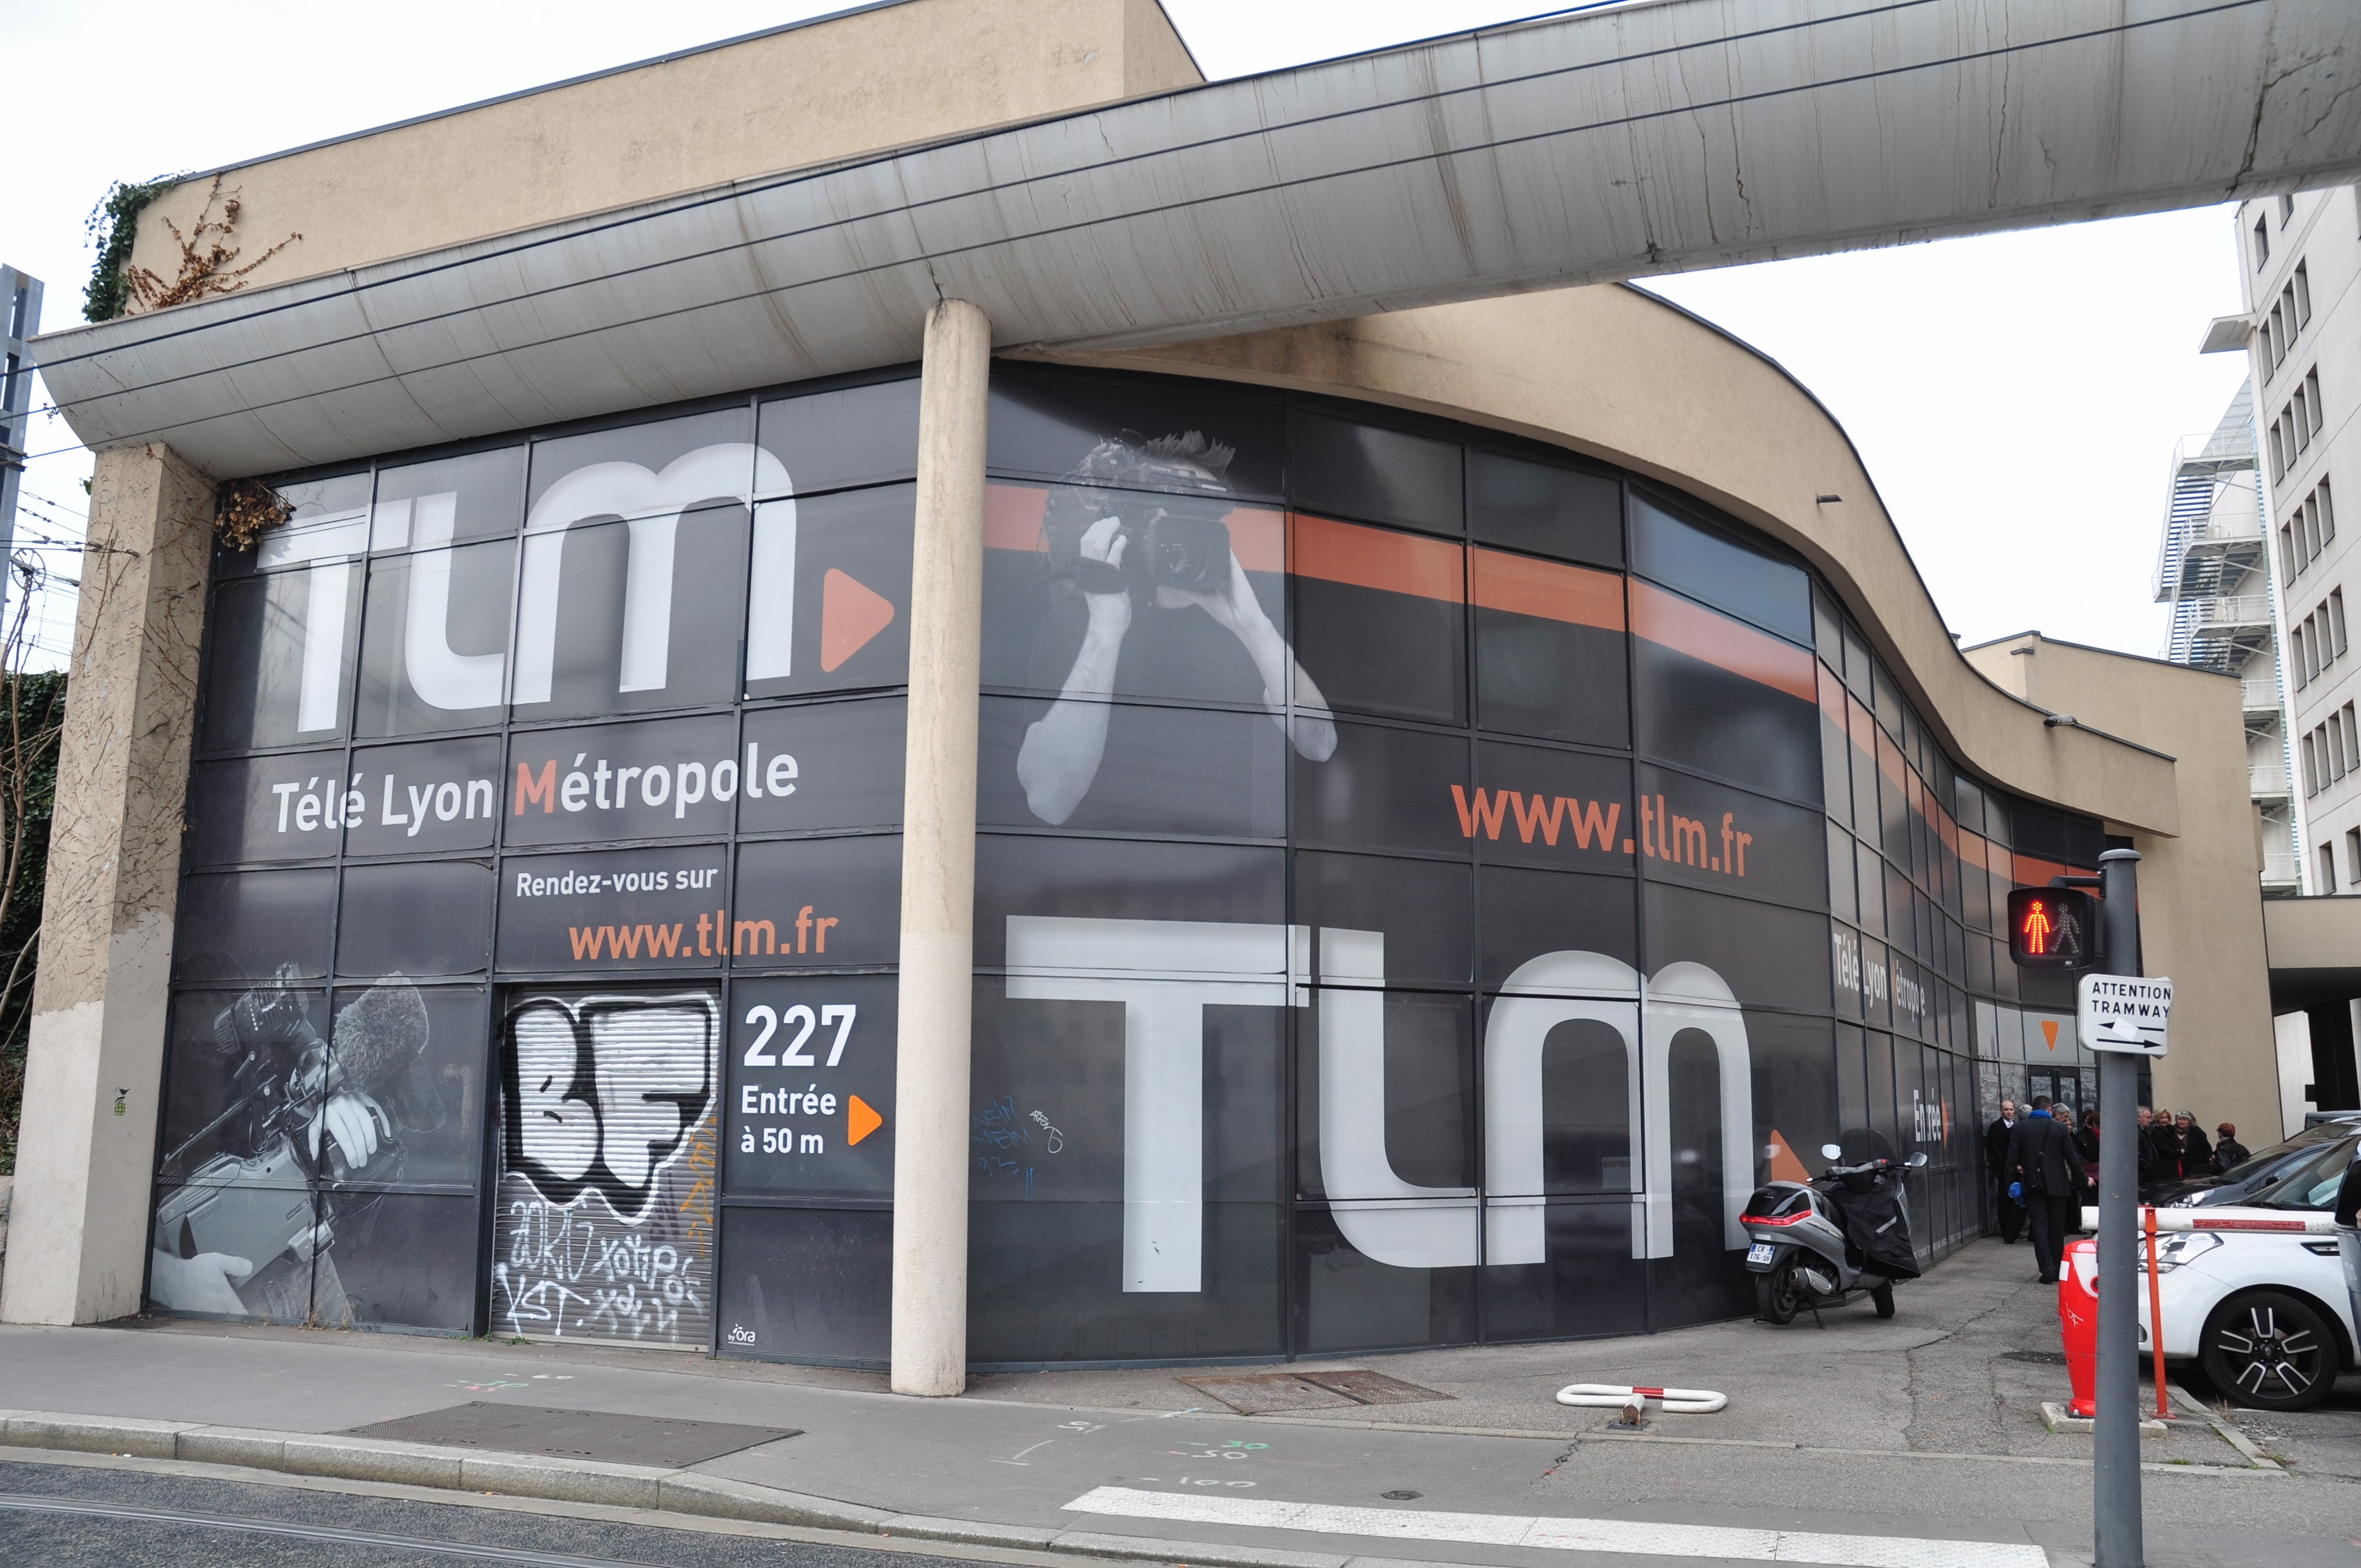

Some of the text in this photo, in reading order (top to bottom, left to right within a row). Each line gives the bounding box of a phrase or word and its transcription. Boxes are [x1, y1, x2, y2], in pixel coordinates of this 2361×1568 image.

[271, 742, 798, 837] Télé Lyon Métropole
[1450, 784, 1753, 877] www.tlm.fr
[516, 866, 718, 897] Rendez-vous sur
[569, 905, 839, 960] www.tlm.fr
[1834, 933, 1859, 992] Télé
[1862, 946, 1887, 1008] Lyon
[2092, 982, 2171, 1000] ATTENTION
[2092, 1000, 2170, 1019] TRAMWAY
[743, 1004, 857, 1067] 227
[741, 1084, 837, 1115] Entrée
[741, 1126, 824, 1155] à 50 m
[728, 1333, 736, 1342] by
